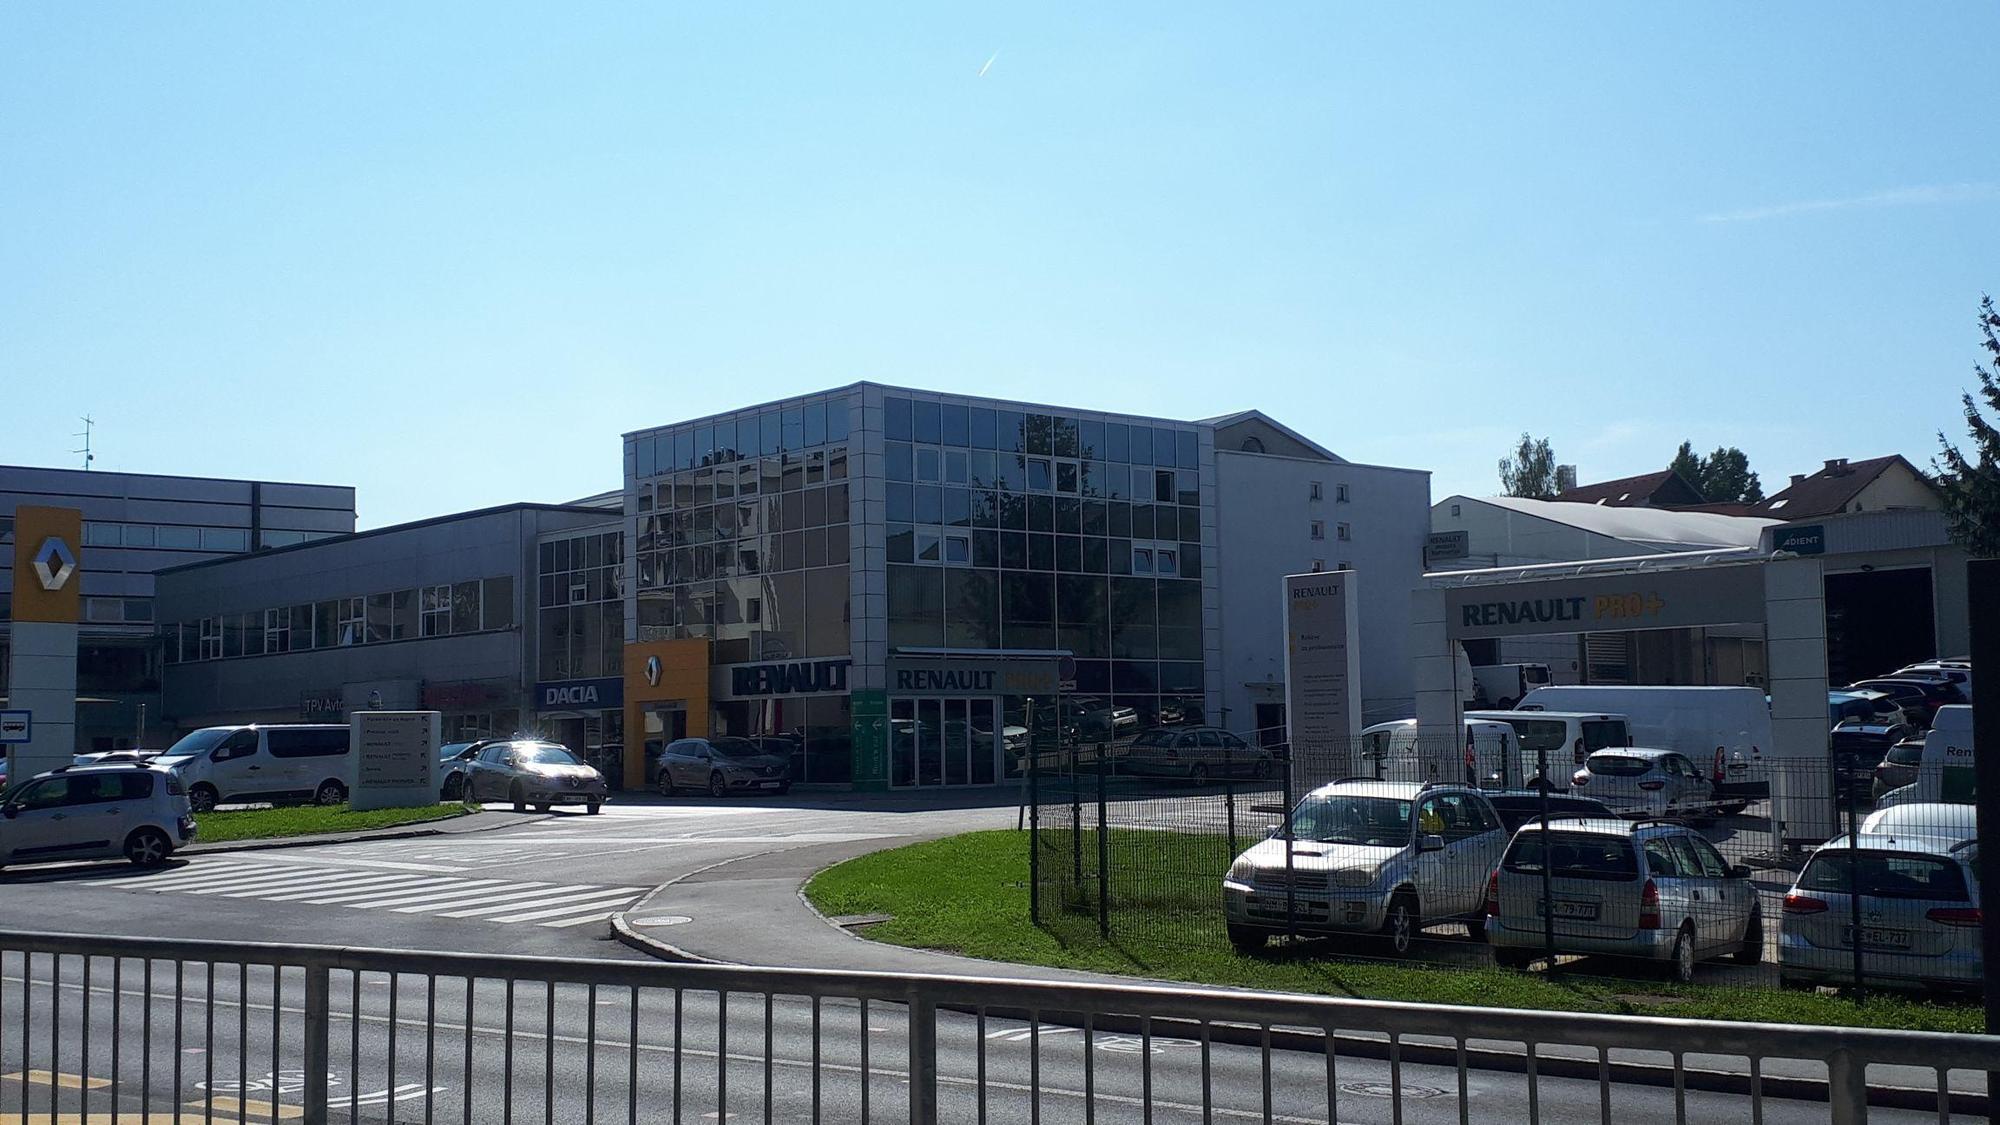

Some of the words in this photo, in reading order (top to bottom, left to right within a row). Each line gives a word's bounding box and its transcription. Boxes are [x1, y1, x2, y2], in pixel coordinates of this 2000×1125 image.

[1783, 535, 1819, 546] ADIENT
[1293, 586, 1339, 599] RENAULT
[1462, 597, 1586, 627] RENAULT
[1594, 592, 1665, 620] PRO+
[732, 660, 852, 695] RENAULT
[896, 669, 996, 690] RENAULT
[546, 686, 599, 705] DACIA
[304, 698, 323, 713] TPV
[1947, 746, 1975, 757] Ren
